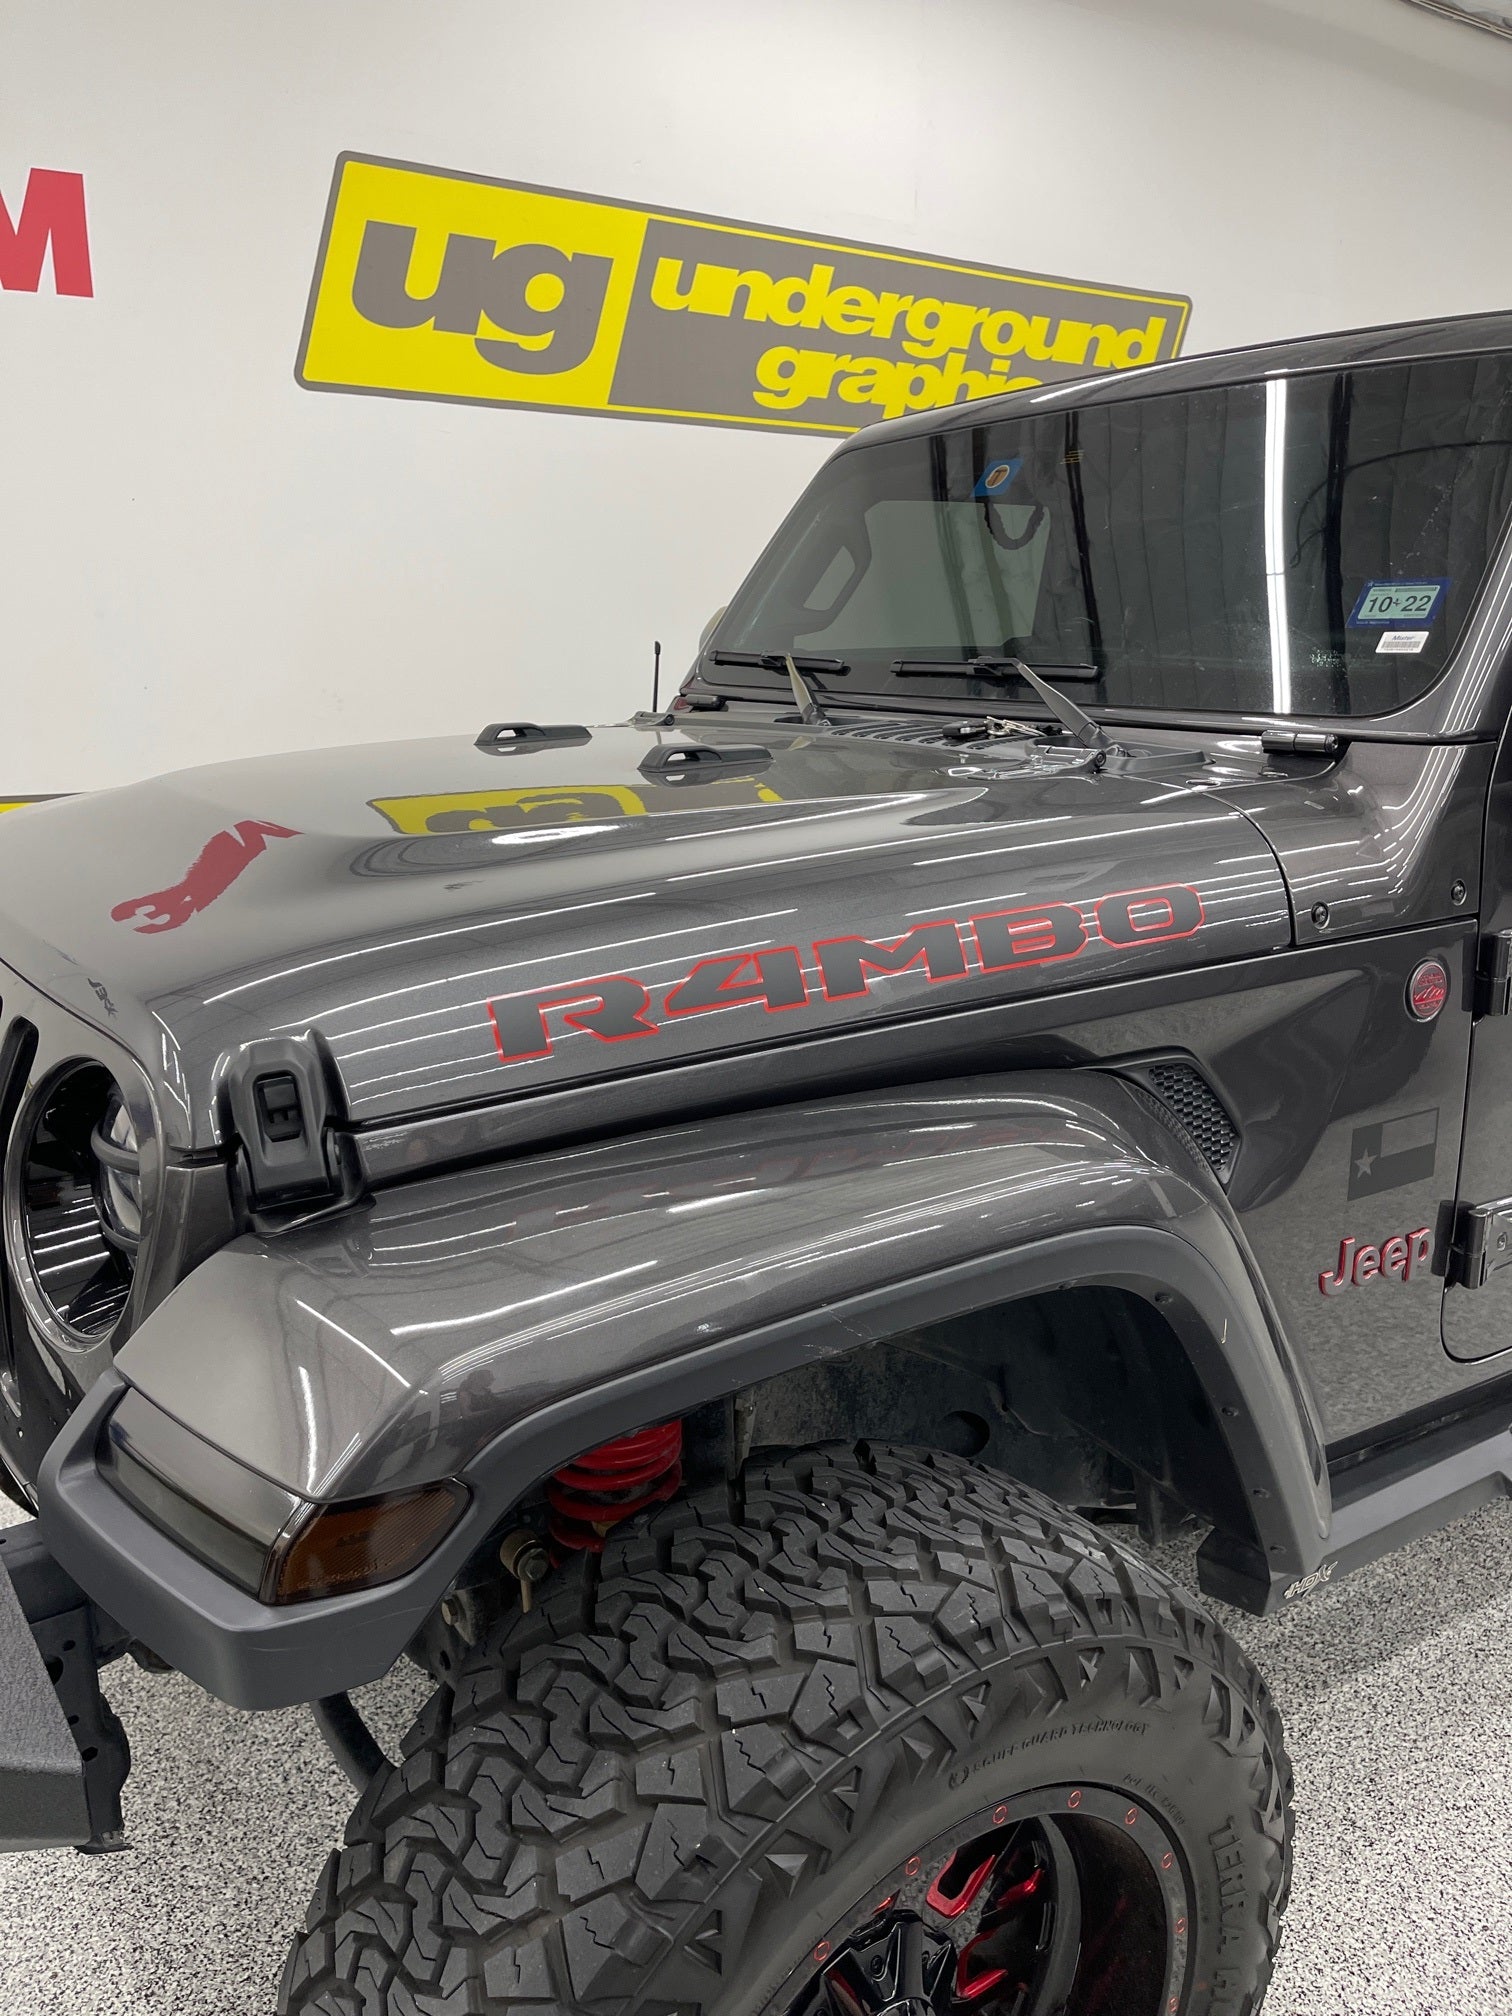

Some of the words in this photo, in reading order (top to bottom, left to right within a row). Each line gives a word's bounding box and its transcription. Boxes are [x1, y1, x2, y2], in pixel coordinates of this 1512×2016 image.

[351, 219, 614, 377] ug
[650, 256, 1167, 370] underground
[753, 345, 1043, 420] graphi
[487, 882, 1204, 1062] R4MBO
[1319, 1226, 1436, 1298] Jeep
